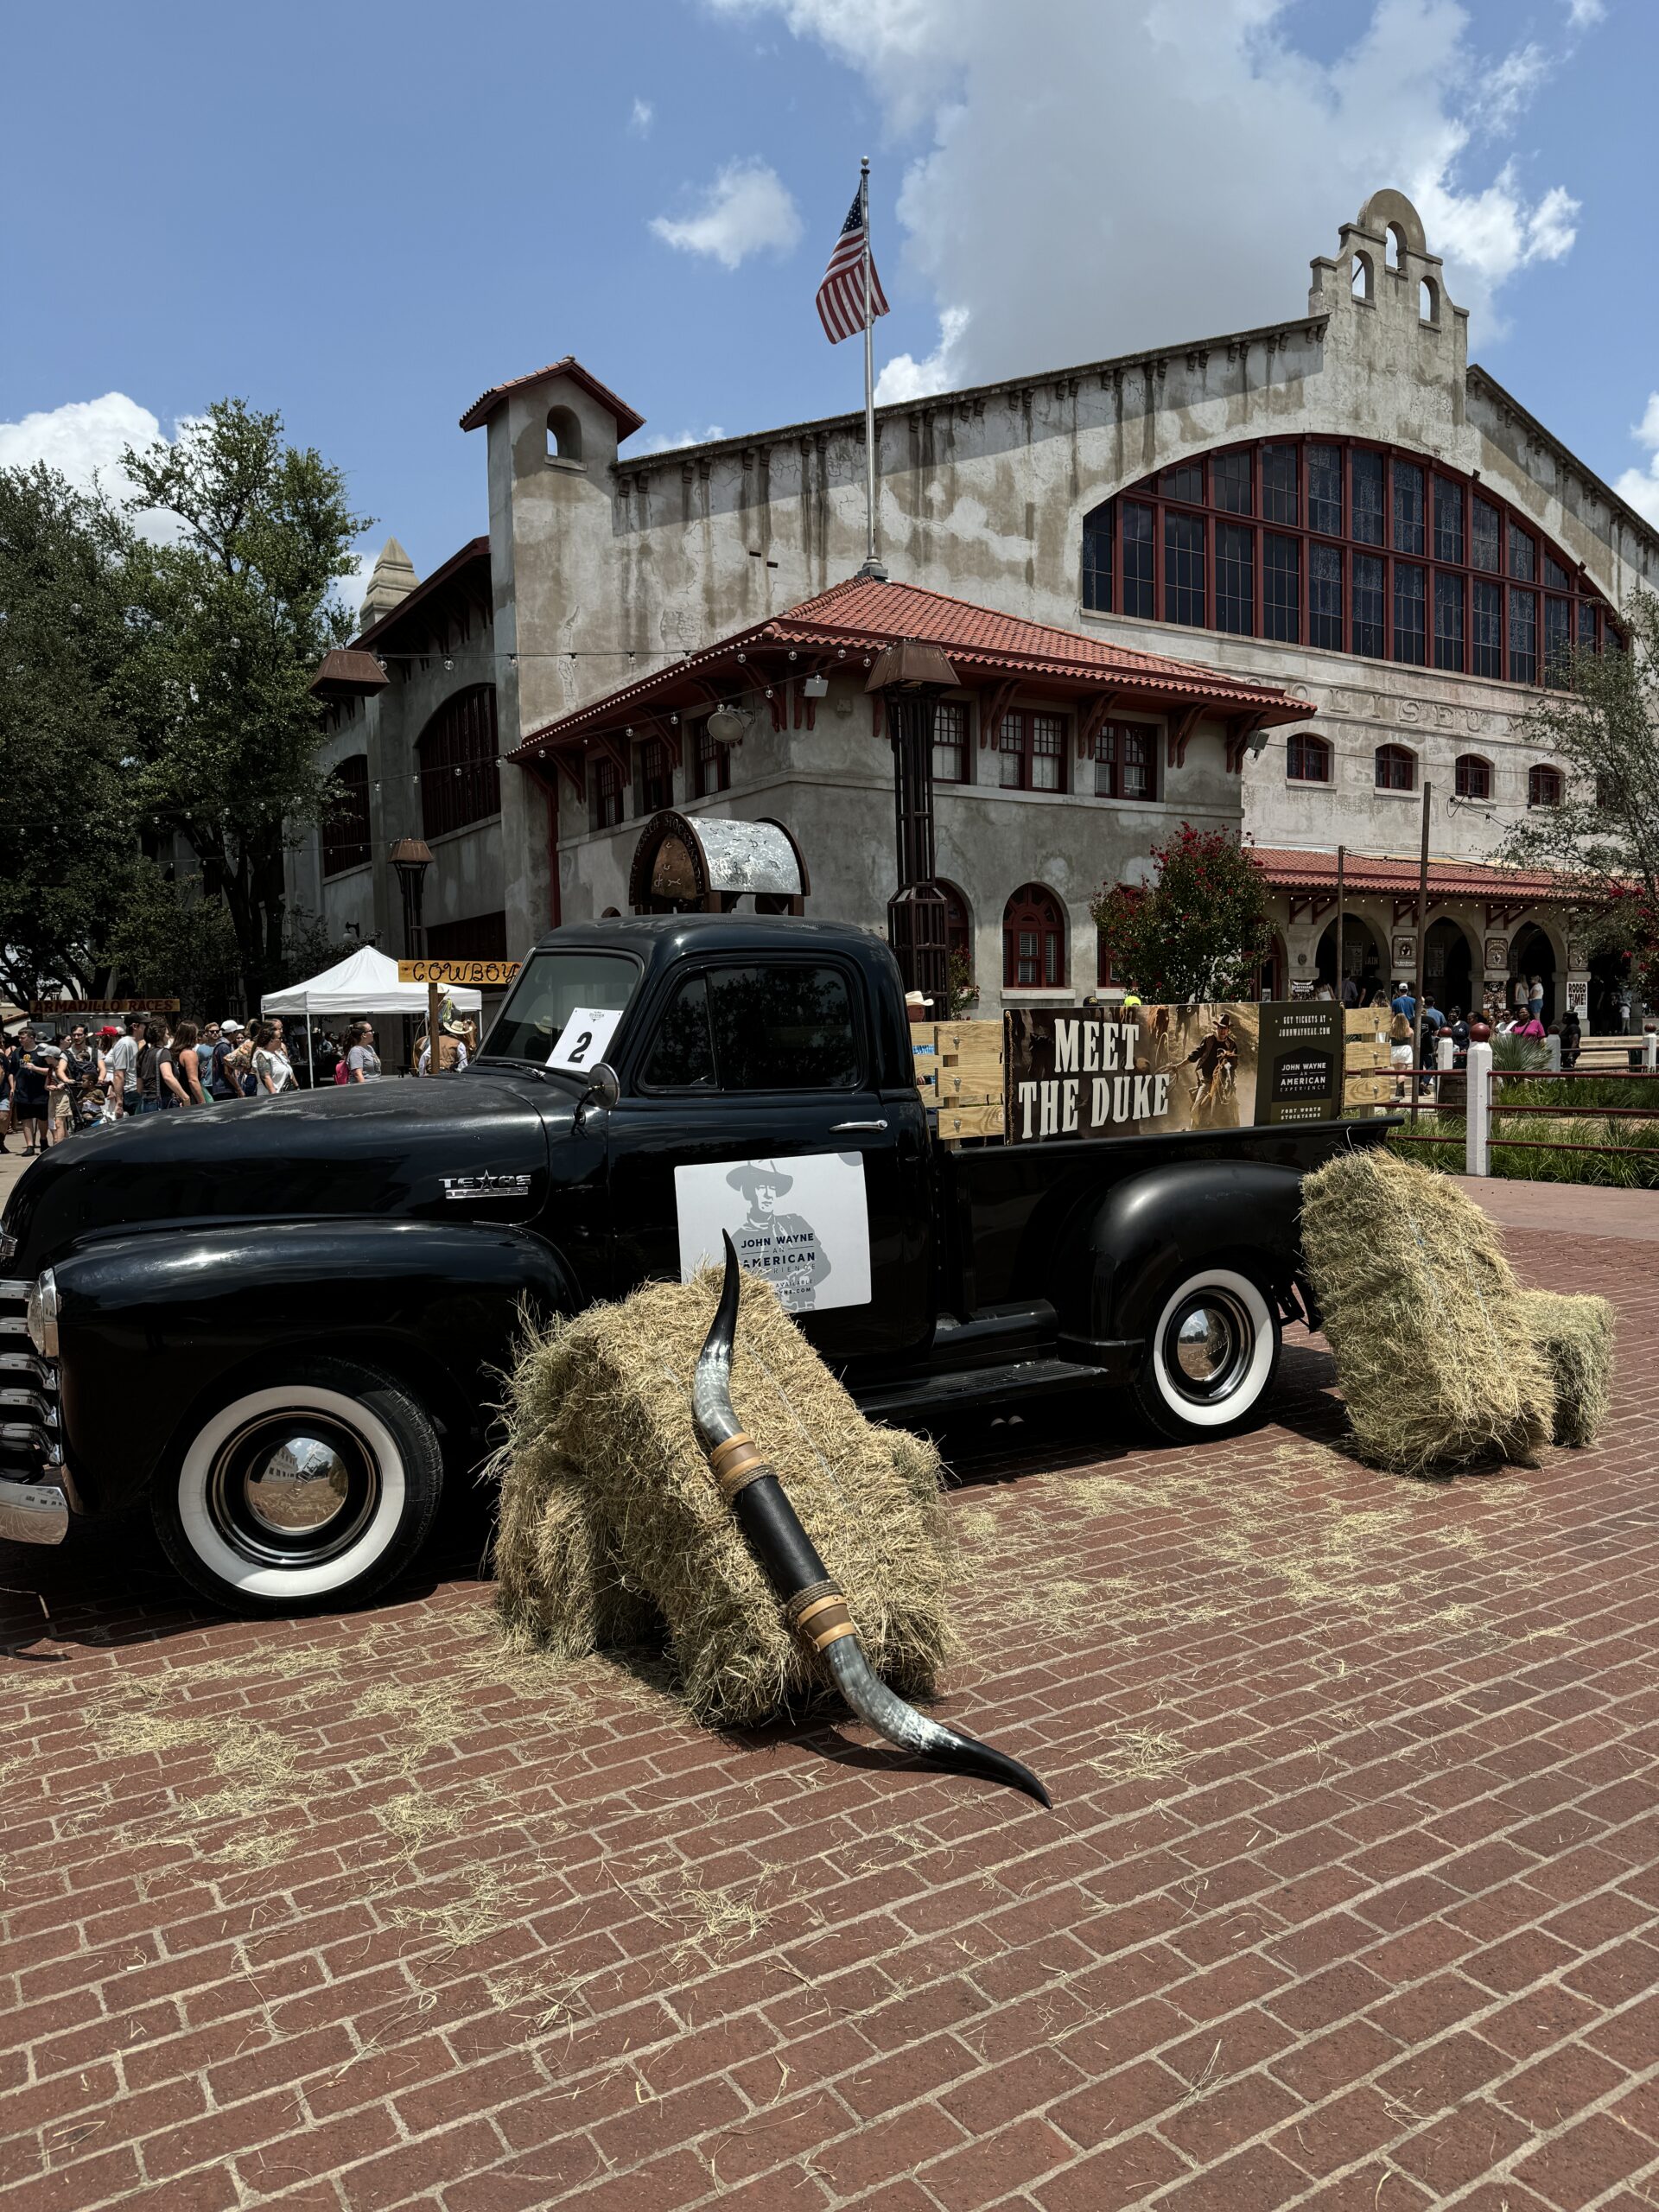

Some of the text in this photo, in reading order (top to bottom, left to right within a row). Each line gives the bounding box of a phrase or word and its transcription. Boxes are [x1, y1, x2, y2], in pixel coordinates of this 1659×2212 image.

[1246, 677, 1532, 741] OLISEUM
[413, 962, 520, 983] COWBOY
[1568, 983, 1586, 994] RODEO
[34, 1000, 173, 1013] ARMADILLO RACES
[1283, 1014, 1326, 1025] GET TICKETS AT
[567, 1032, 593, 1064] 2
[1053, 1018, 1139, 1073] MEET
[1281, 1077, 1326, 1086] AMERICAN
[1018, 1074, 1170, 1140] THE DUKE
[741, 1233, 814, 1249] JOHN WAYNE
[743, 1252, 815, 1268] AMERICAN
